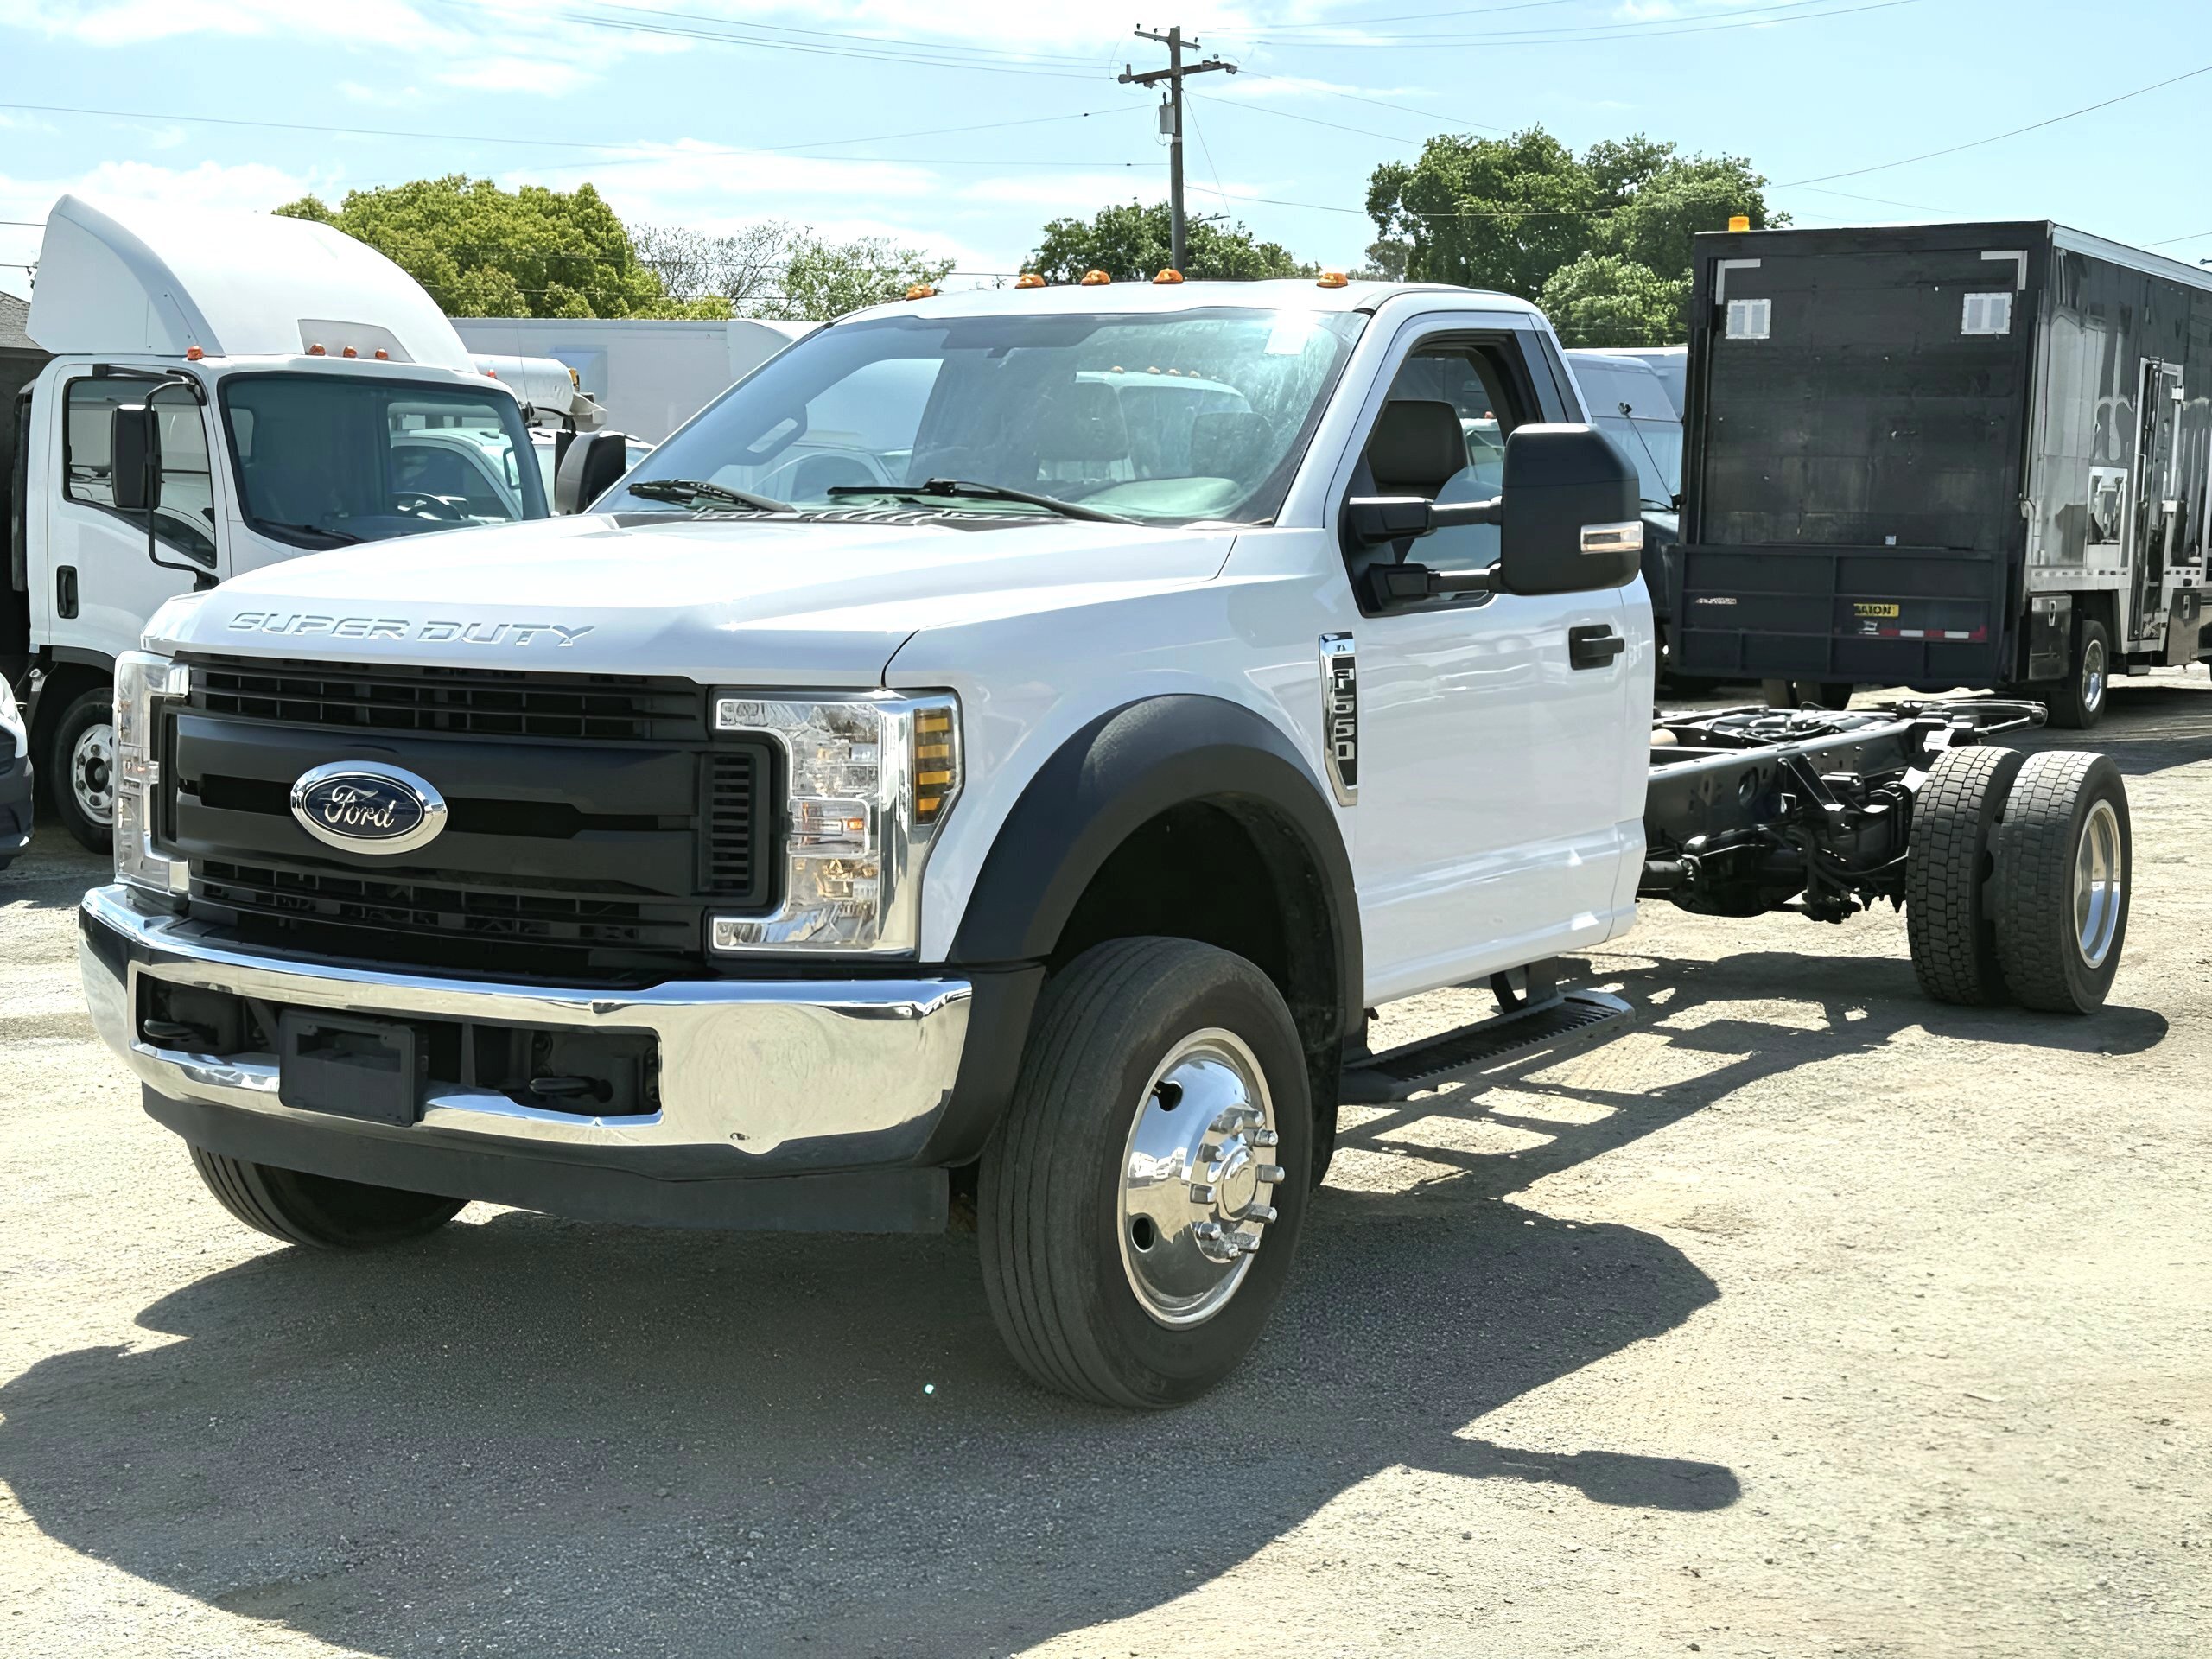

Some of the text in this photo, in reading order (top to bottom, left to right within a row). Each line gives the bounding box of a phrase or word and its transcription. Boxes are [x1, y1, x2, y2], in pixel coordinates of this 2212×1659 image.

[227, 611, 595, 647] SUPER DUTY
[321, 785, 397, 829] Ford
